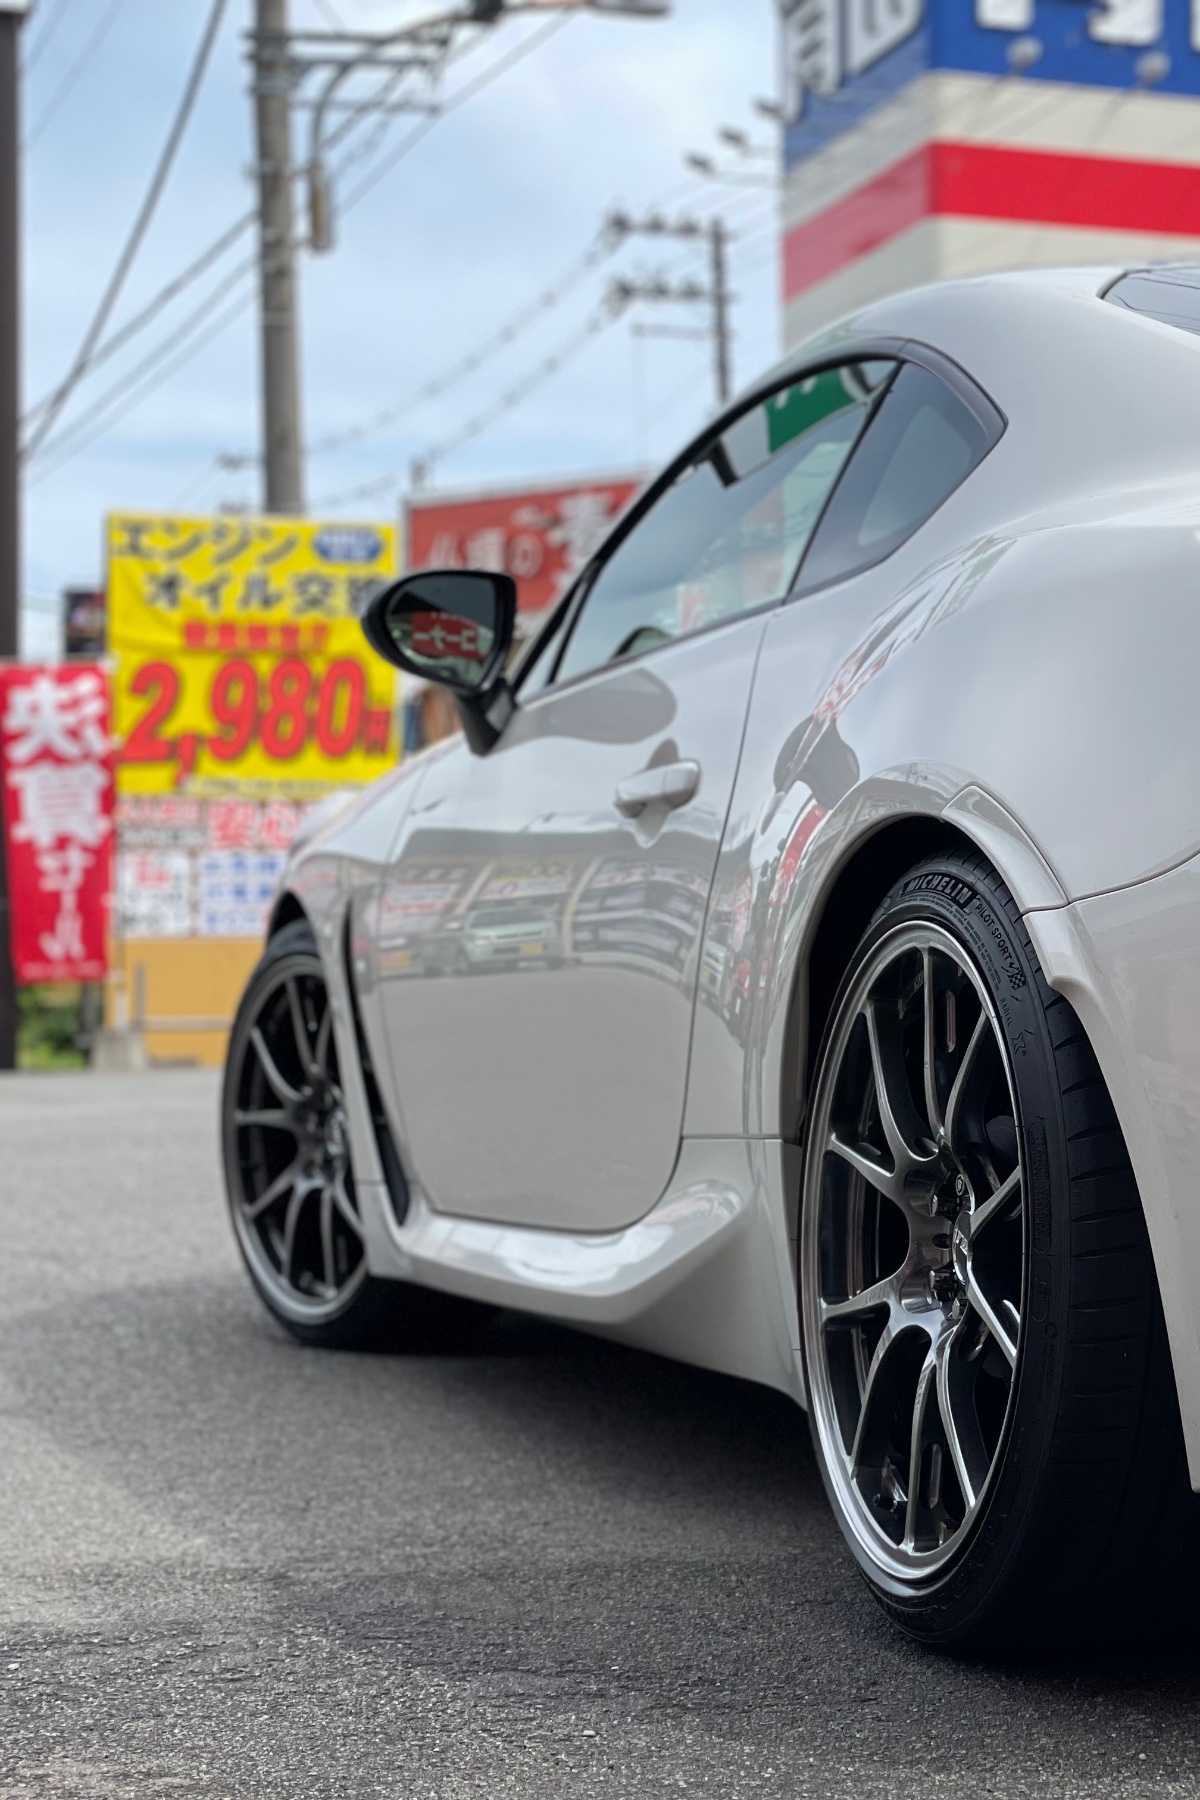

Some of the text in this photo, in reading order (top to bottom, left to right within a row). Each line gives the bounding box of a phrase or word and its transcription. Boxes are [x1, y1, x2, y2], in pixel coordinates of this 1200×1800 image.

[114, 521, 299, 564] エンジン
[904, 875, 973, 904] MICHELIN
[975, 903, 995, 928] PILOT
[991, 926, 1013, 961] SPORT
